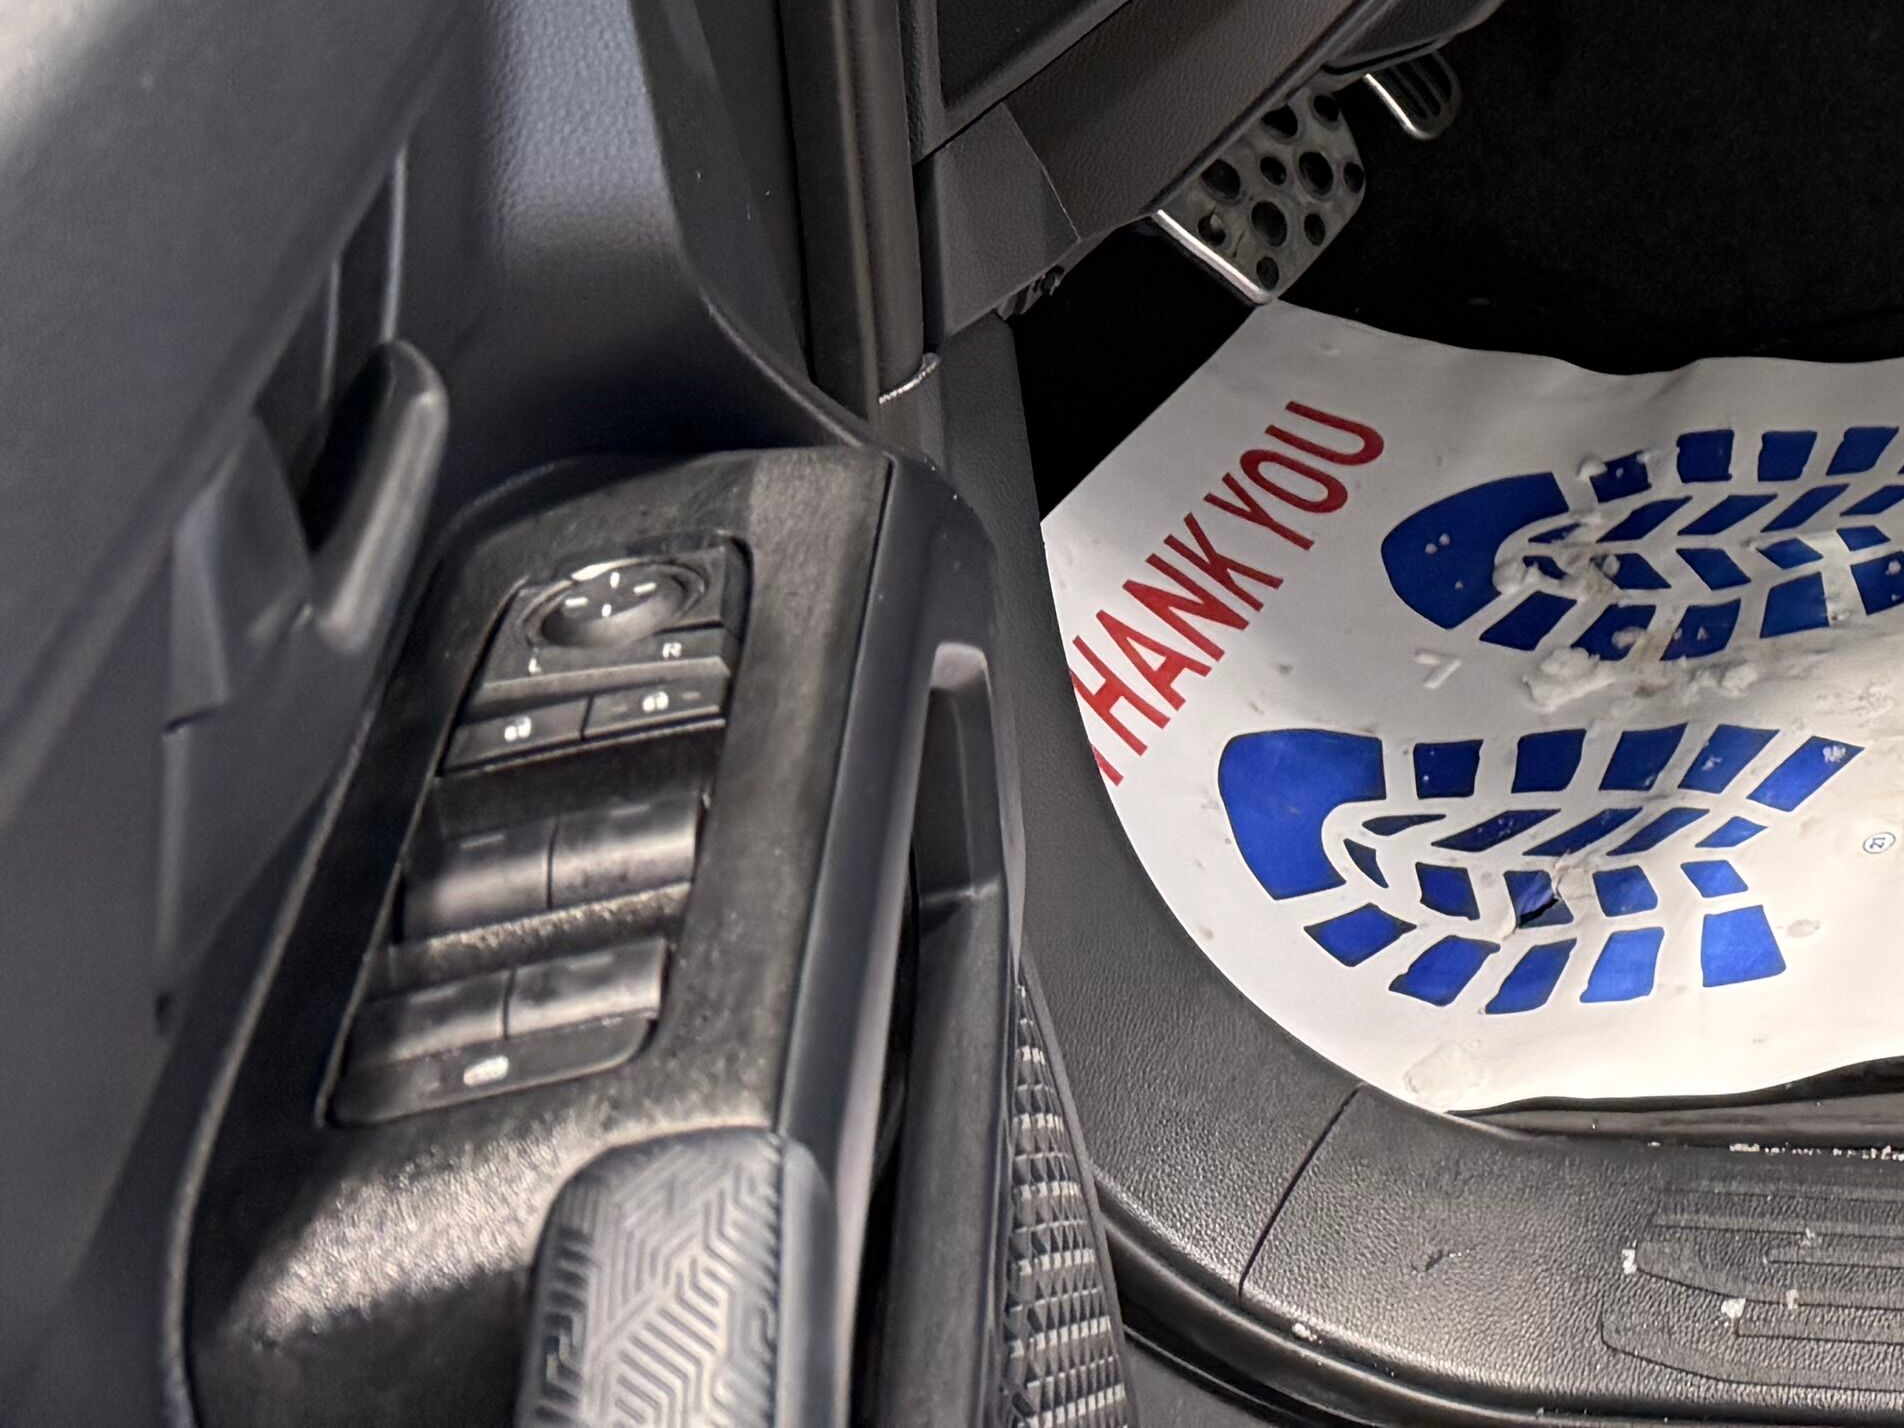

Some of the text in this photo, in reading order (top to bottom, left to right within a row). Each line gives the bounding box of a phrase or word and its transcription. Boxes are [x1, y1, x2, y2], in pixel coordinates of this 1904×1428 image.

[662, 642, 682, 658] R
[1069, 401, 1385, 786] HANK YOU
